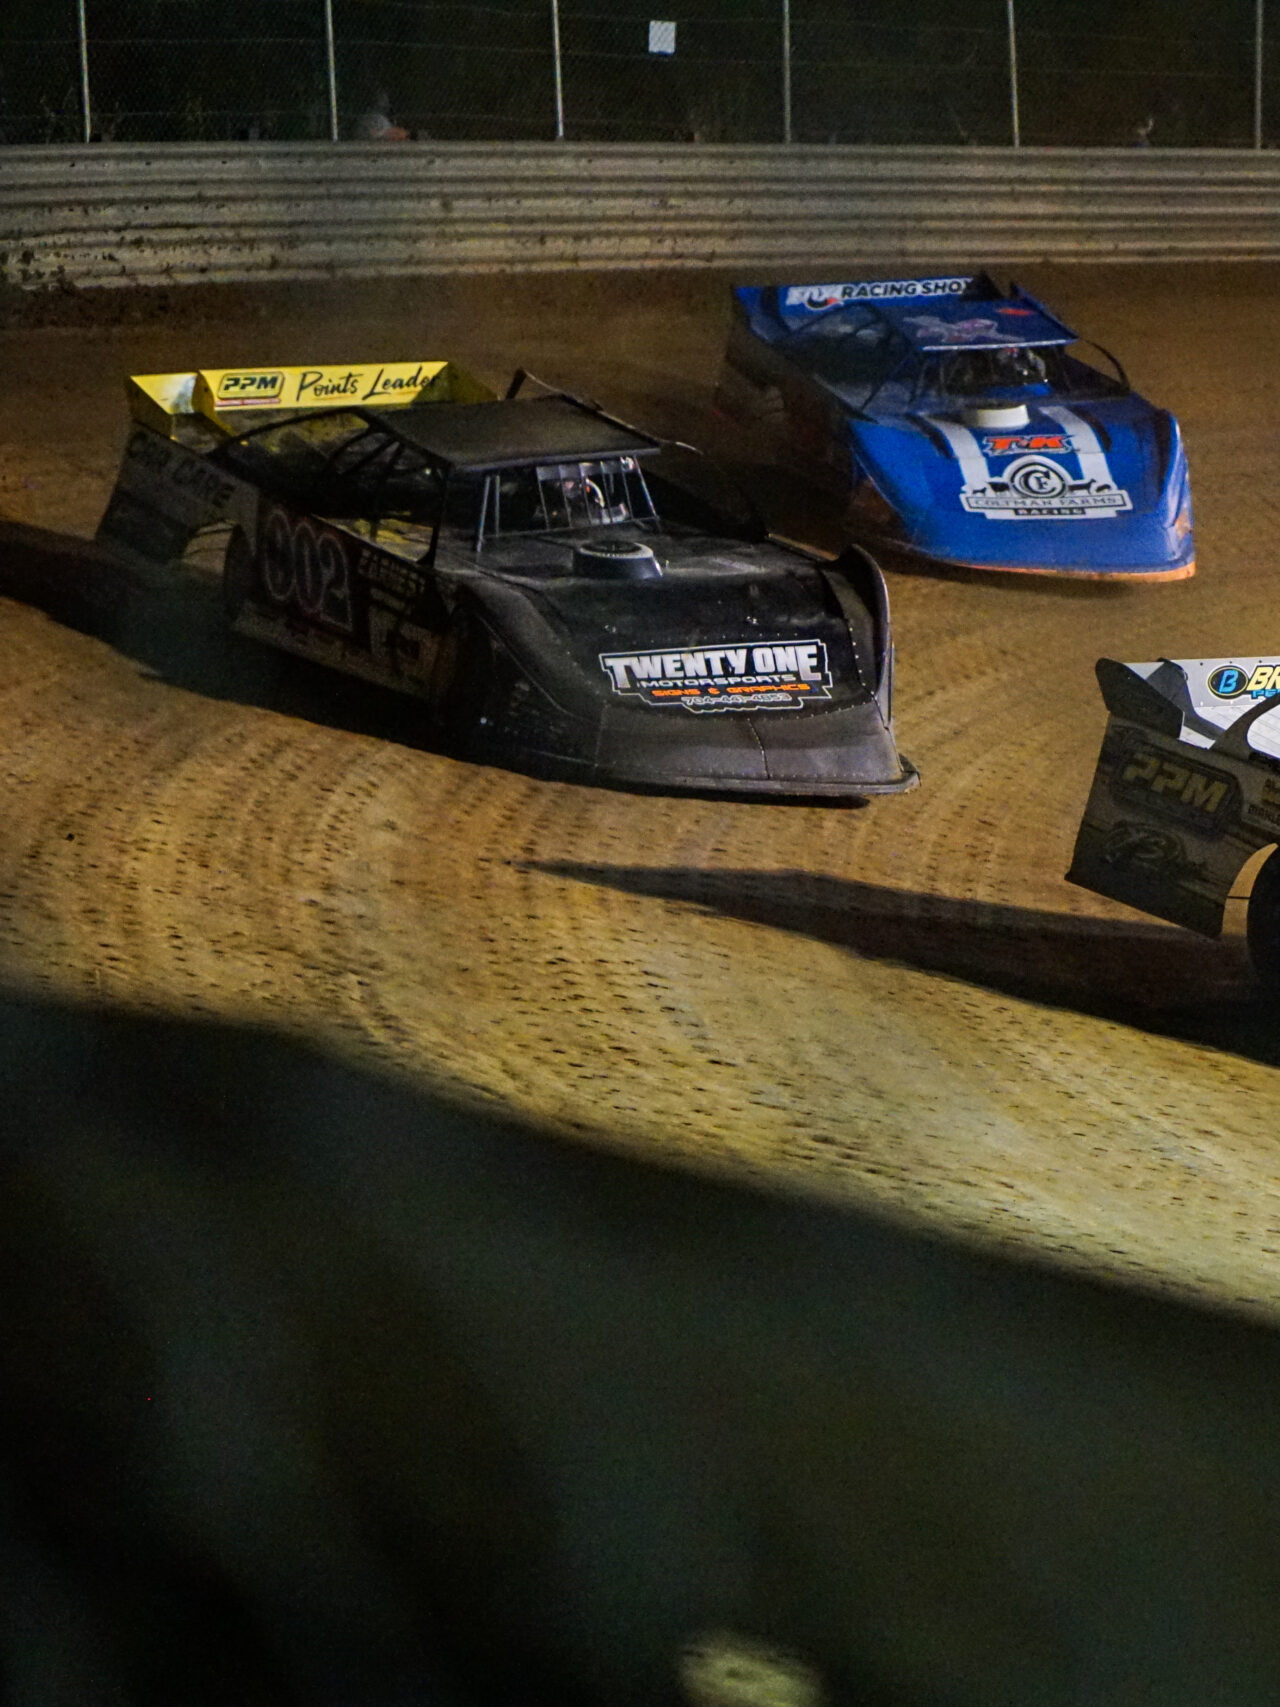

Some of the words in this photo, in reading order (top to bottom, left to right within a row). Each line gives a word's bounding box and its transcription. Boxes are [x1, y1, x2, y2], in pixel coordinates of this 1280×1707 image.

[841, 282, 917, 299] RACING
[223, 376, 278, 391] PPM
[296, 370, 364, 402] Points
[362, 366, 439, 400] Leader
[1058, 497, 1117, 507] FARMS
[605, 648, 748, 689] TWENTY
[753, 645, 822, 682] ONE
[638, 673, 796, 689] MOTORSPORTS
[651, 688, 701, 697] SIGNS
[726, 683, 811, 694] GRAPHICS
[1122, 752, 1228, 813] PPM
